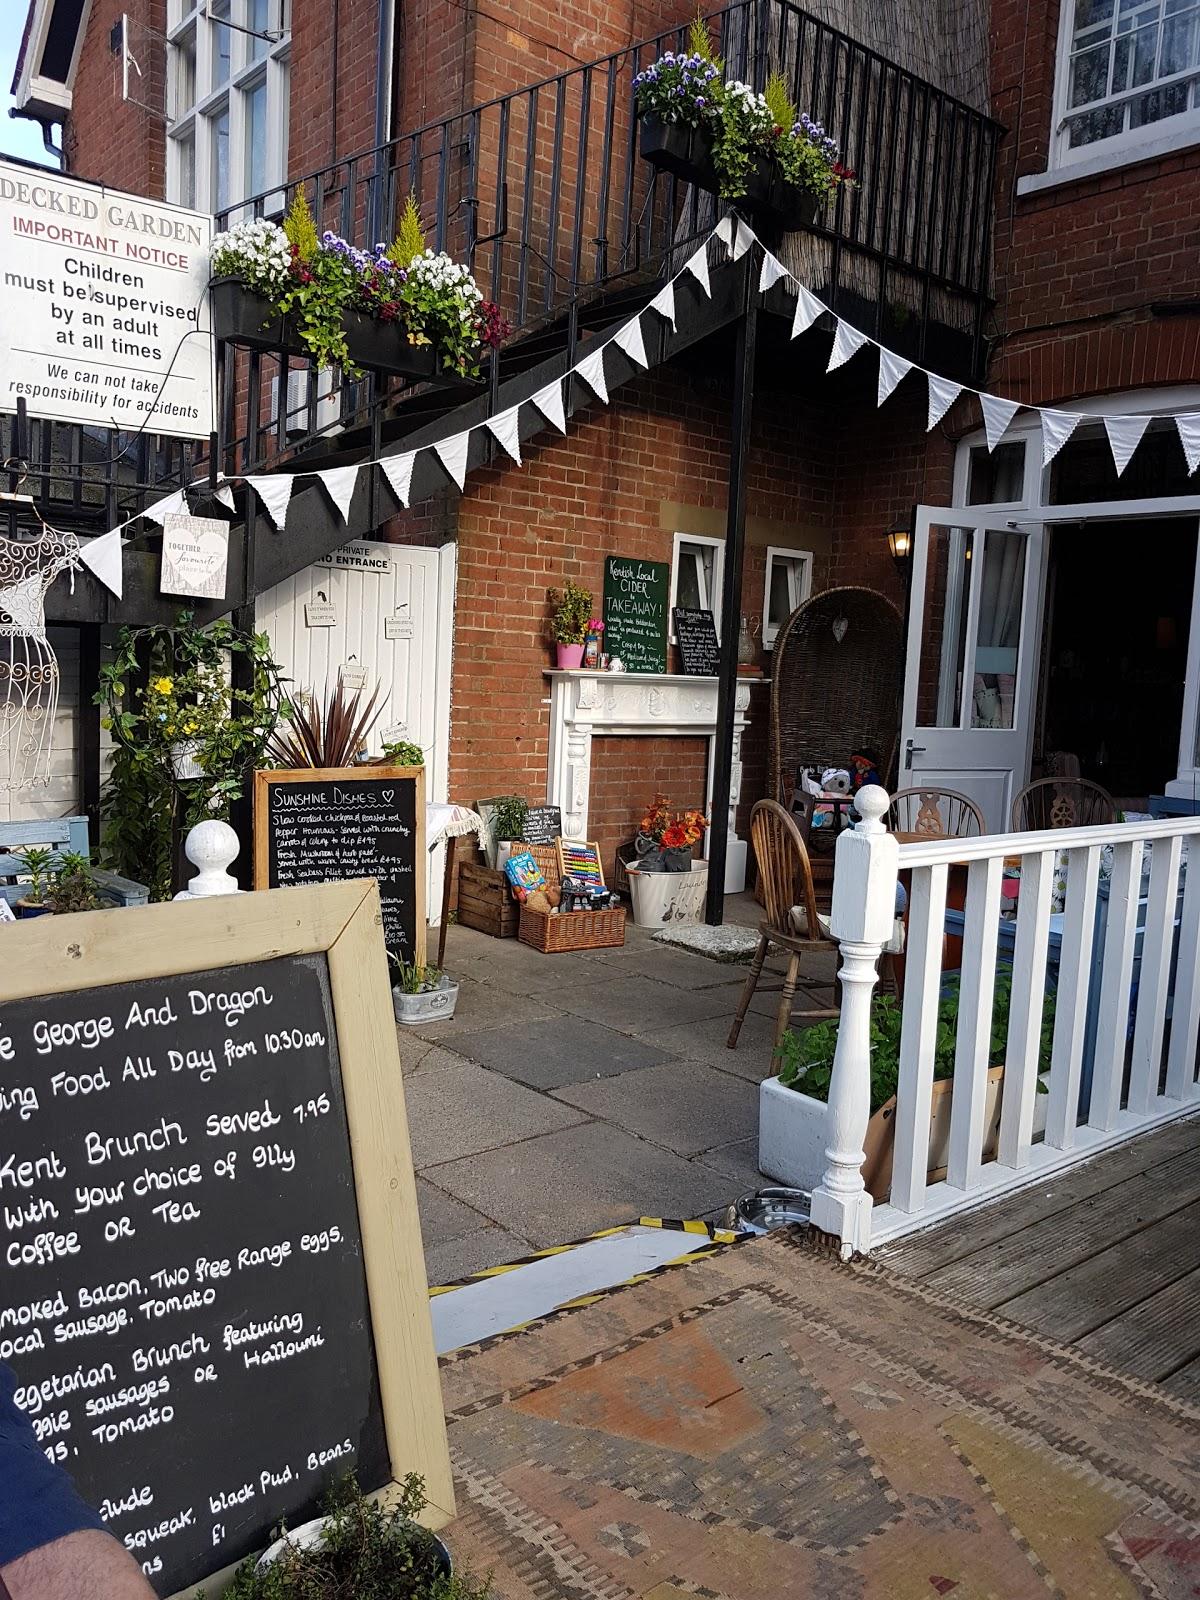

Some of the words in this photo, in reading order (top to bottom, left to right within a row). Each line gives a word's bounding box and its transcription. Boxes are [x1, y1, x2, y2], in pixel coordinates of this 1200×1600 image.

[0, 178, 98, 220] DECKED
[108, 206, 202, 245] GARDEN
[13, 216, 119, 253] IMPORTANT
[126, 243, 189, 269] NOTICE
[64, 258, 144, 288] Children
[5, 272, 55, 294] must
[63, 281, 87, 300] be
[94, 289, 197, 321] supervised
[51, 302, 74, 325] by
[82, 311, 104, 327] an
[113, 315, 158, 337] adult
[56, 330, 75, 345] at
[82, 333, 103, 350] all
[111, 338, 162, 360] times
[47, 363, 68, 379] We
[74, 370, 98, 384] can
[104, 373, 126, 388] not
[131, 377, 159, 394] take
[9, 381, 107, 408] responsibility
[113, 393, 131, 409] for
[136, 400, 199, 419] accidents
[169, 542, 200, 552] TOGETHER
[175, 551, 214, 565] favourite
[336, 556, 388, 568] ENTRANCE
[337, 545, 370, 556] PRIVATE
[620, 579, 650, 598] CIDER
[636, 563, 659, 583] Local
[273, 788, 327, 807] SUNSHINE
[333, 787, 377, 804] DISHES
[273, 815, 295, 825] Slow
[388, 813, 401, 822] red
[381, 825, 410, 837] crunchy
[277, 849, 297, 859] Fresh
[341, 836, 355, 846] dip
[277, 870, 295, 880] Fresh
[345, 868, 366, 876] served
[33, 1016, 115, 1053] George
[125, 997, 178, 1029] And
[188, 986, 273, 1027] Dragon
[51, 1066, 111, 1096] Food
[122, 1056, 157, 1082] All
[167, 1049, 217, 1082] Day
[224, 1038, 258, 1067] from
[0, 1151, 67, 1189] Kent
[85, 1118, 188, 1165] Brunch
[293, 1093, 331, 1124] 7.95
[74, 1181, 125, 1214] your
[133, 1163, 203, 1195] choice
[214, 1151, 238, 1180] of
[152, 1201, 201, 1224] Tea
[0, 1290, 69, 1329] moked
[78, 1277, 148, 1308] Bacon,
[195, 1257, 232, 1282] free
[238, 1240, 292, 1269] Range
[300, 1226, 345, 1254] eggs,
[0, 1328, 45, 1360] ocal
[140, 1288, 216, 1320] Tomato
[13, 1362, 117, 1414] egetarian
[132, 1333, 211, 1373] Brunch
[222, 1312, 303, 1351] featuring
[32, 1409, 72, 1441] ggie
[85, 1376, 170, 1417] sausages
[244, 1326, 325, 1369] Halloumi
[92, 1405, 174, 1443] Tomato
[209, 1483, 255, 1514] black
[307, 1438, 355, 1470] Beans,
